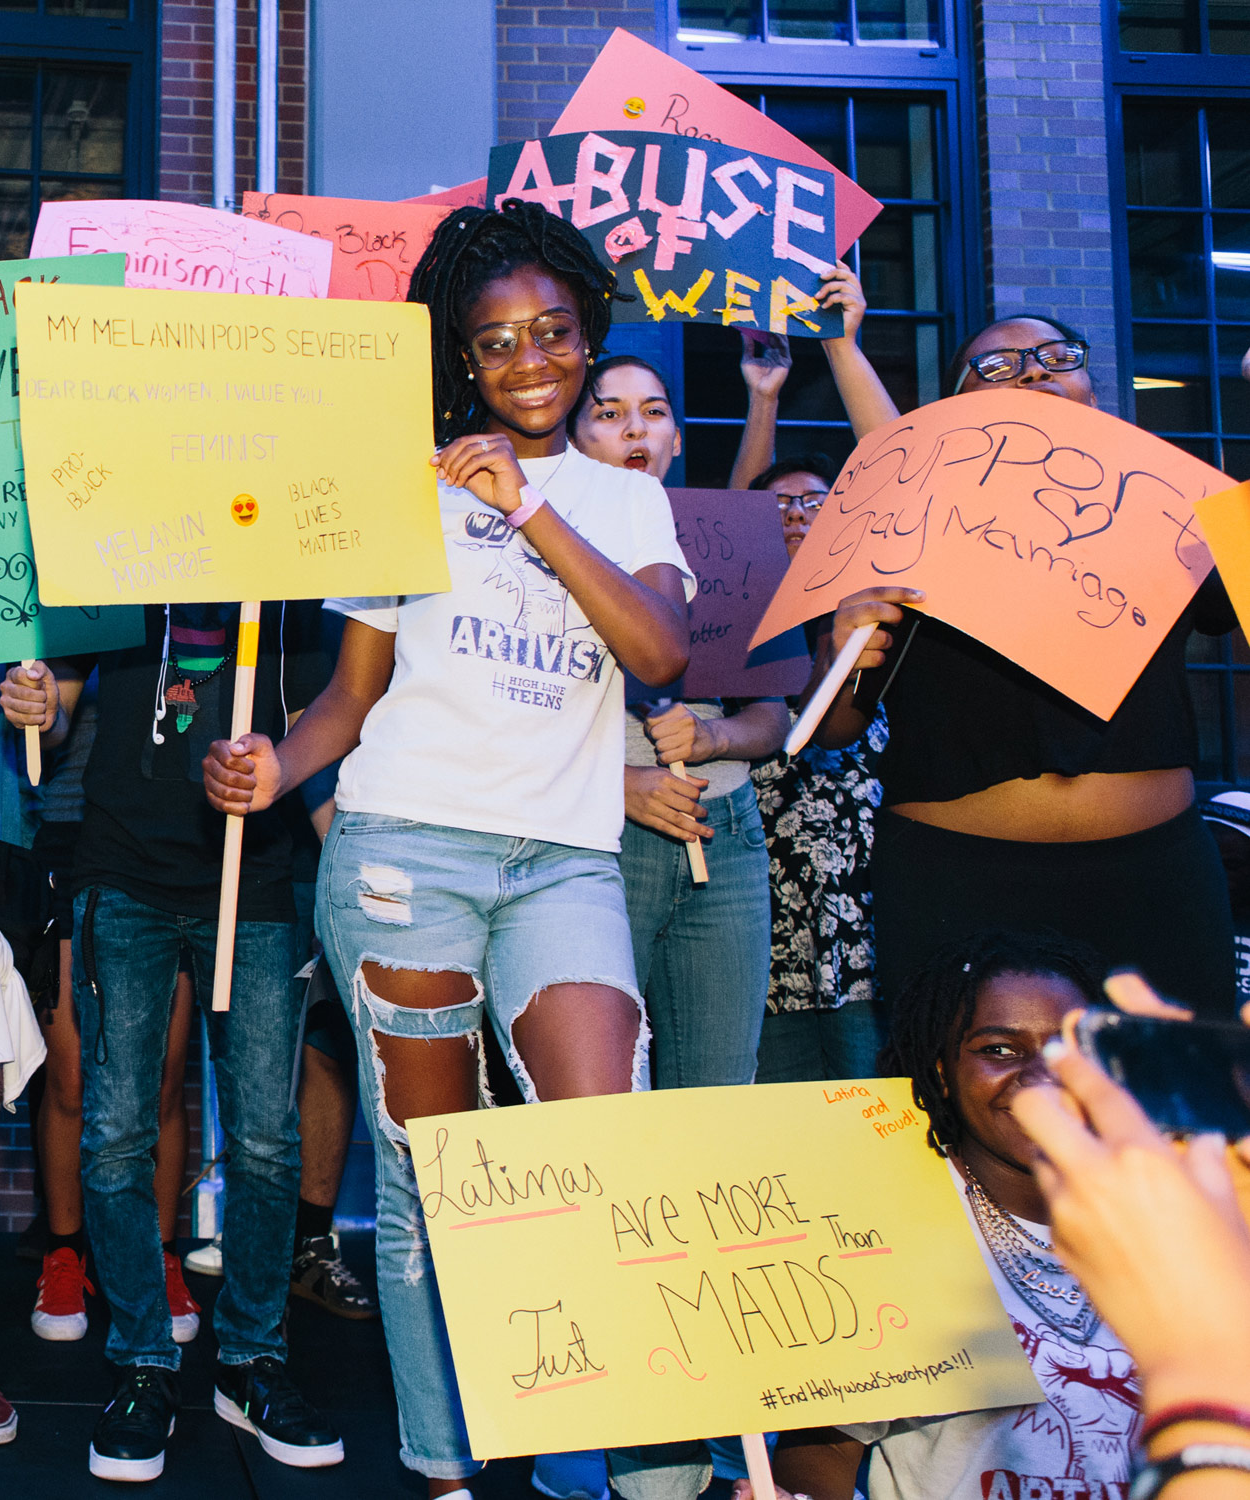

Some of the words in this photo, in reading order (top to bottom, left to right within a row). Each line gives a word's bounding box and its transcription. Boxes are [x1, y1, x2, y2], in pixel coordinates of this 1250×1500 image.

[495, 132, 836, 276] ABUSE
[48, 315, 81, 343] MY
[93, 317, 205, 350] MELANIN
[212, 324, 275, 353] POPS
[287, 330, 399, 360] SEVERELY
[25, 378, 75, 400] DEAR
[81, 379, 140, 403] BLACK
[233, 383, 284, 402] VALUE
[171, 433, 280, 462] FEMINIST
[66, 462, 114, 511] BLACK
[287, 476, 340, 502] BLACK
[294, 501, 342, 531] LIVES
[94, 511, 205, 566] MELANIN
[299, 529, 362, 557] MATTER
[804, 494, 934, 592] gay
[507, 687, 562, 711] TEENS
[509, 676, 539, 690] HIGH
[542, 682, 566, 696] LINE
[822, 1085, 871, 1108] Latina
[862, 1100, 890, 1121] and
[872, 1108, 920, 1139] Proud!
[422, 1127, 603, 1219] Latinas
[698, 1173, 811, 1241] MORE
[821, 1214, 884, 1251] Than
[508, 1300, 606, 1389] Just
